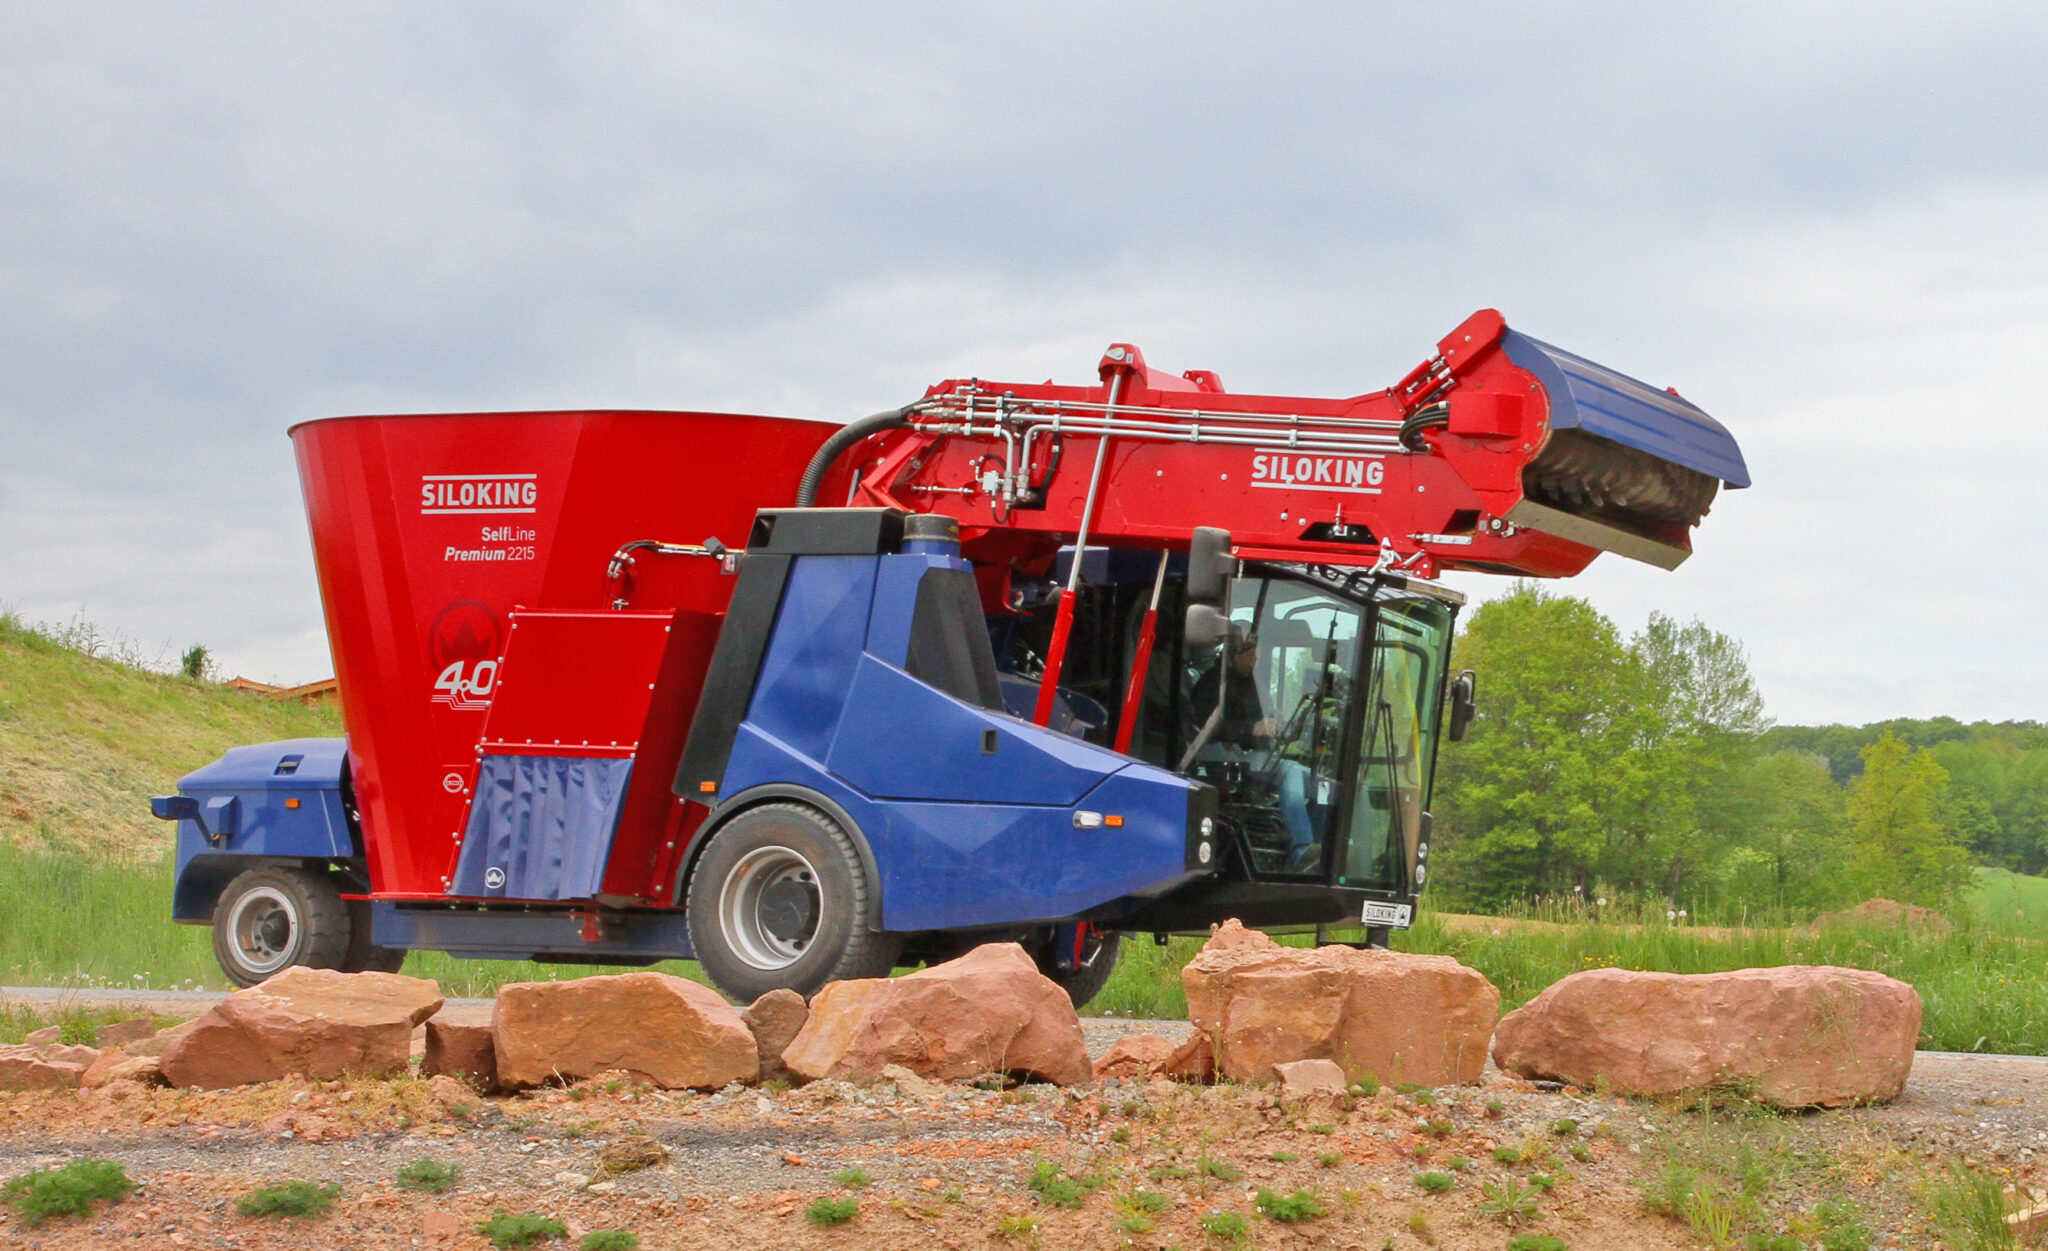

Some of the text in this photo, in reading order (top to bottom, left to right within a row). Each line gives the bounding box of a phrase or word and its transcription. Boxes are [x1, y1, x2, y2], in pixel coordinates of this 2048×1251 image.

[1251, 455, 1384, 485] SILOKING
[421, 482, 537, 506] SILOKING
[481, 526, 536, 541] SelfLine
[444, 546, 535, 561] Premium 2215
[1366, 907, 1396, 920] SILOKING
